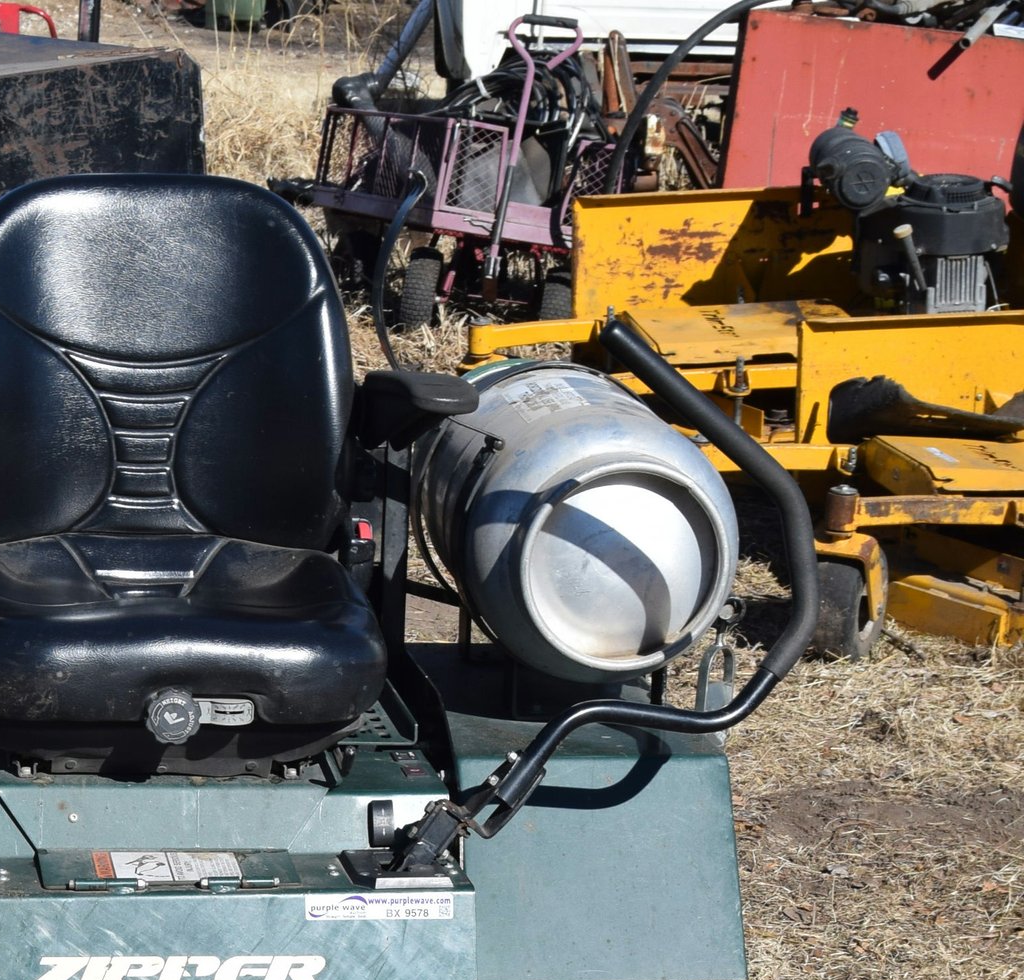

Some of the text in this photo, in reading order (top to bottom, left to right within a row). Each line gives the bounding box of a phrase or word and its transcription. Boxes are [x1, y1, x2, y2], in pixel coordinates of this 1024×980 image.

[368, 896, 451, 906] www.purplewave.com
[310, 904, 339, 912] purple
[386, 909, 429, 918] BX 9578
